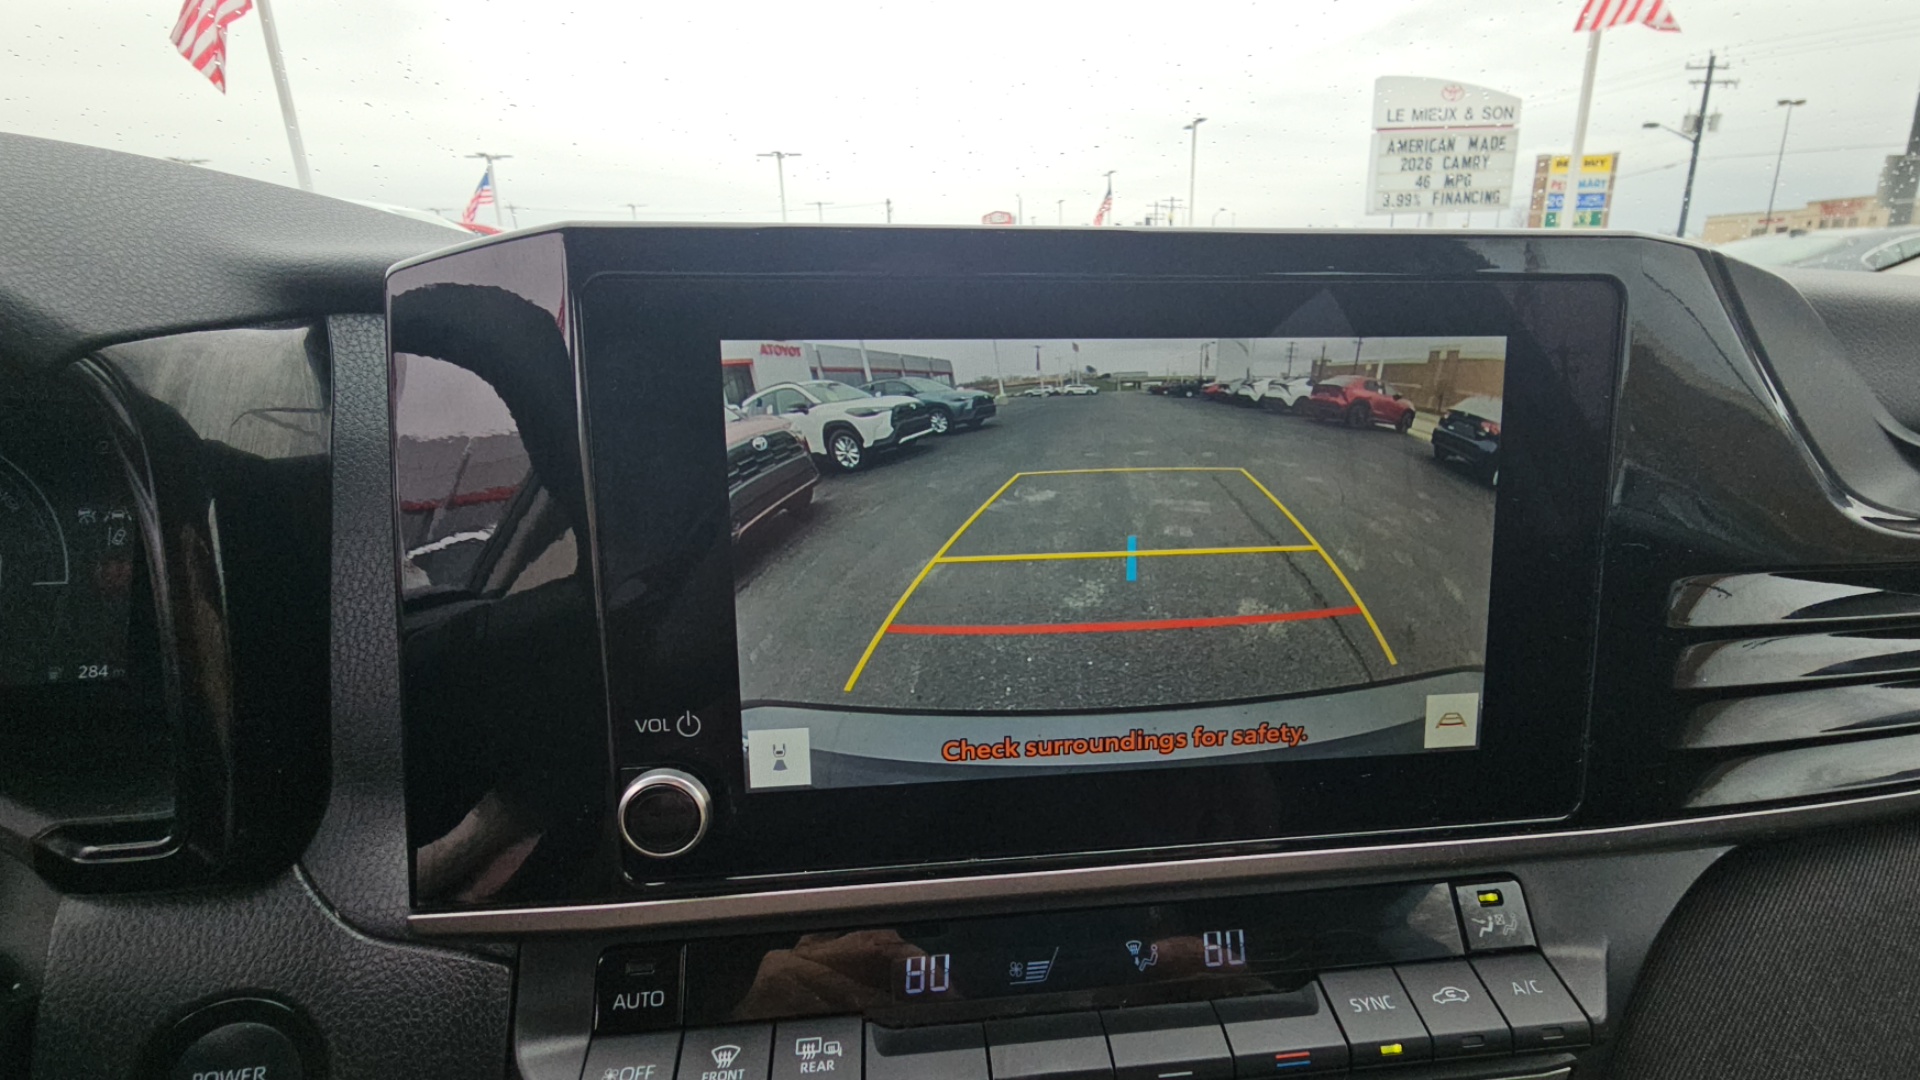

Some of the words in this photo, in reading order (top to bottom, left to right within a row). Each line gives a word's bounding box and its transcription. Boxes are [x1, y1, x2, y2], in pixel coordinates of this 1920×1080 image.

[1387, 108, 1405, 122] LE
[1412, 107, 1457, 121] MIEUX
[1464, 107, 1474, 120] &
[1482, 106, 1514, 120] SON
[1387, 138, 1457, 155] AMERICAN
[1468, 136, 1507, 151] MADE
[1400, 156, 1433, 172] 2026
[1443, 155, 1490, 170] CAMRY
[1415, 175, 1431, 189] 46
[1444, 174, 1472, 188] MPG
[1383, 193, 1421, 208] 3.99%
[1432, 190, 1501, 206] FINANCING
[78, 664, 109, 680] 284
[634, 718, 671, 733] VOL
[942, 737, 1019, 762] Check
[1025, 728, 1188, 757] surroundings
[1192, 726, 1228, 748] for
[1232, 721, 1308, 749] safety.
[1202, 928, 1246, 968] 80
[905, 953, 951, 994] 80
[1511, 979, 1544, 997] A/C
[612, 990, 665, 1011] AUTO
[1349, 995, 1396, 1013] SYNC
[618, 1064, 657, 1080] OFF
[701, 1068, 745, 1080] FRONT
[800, 1060, 836, 1074] REAR
